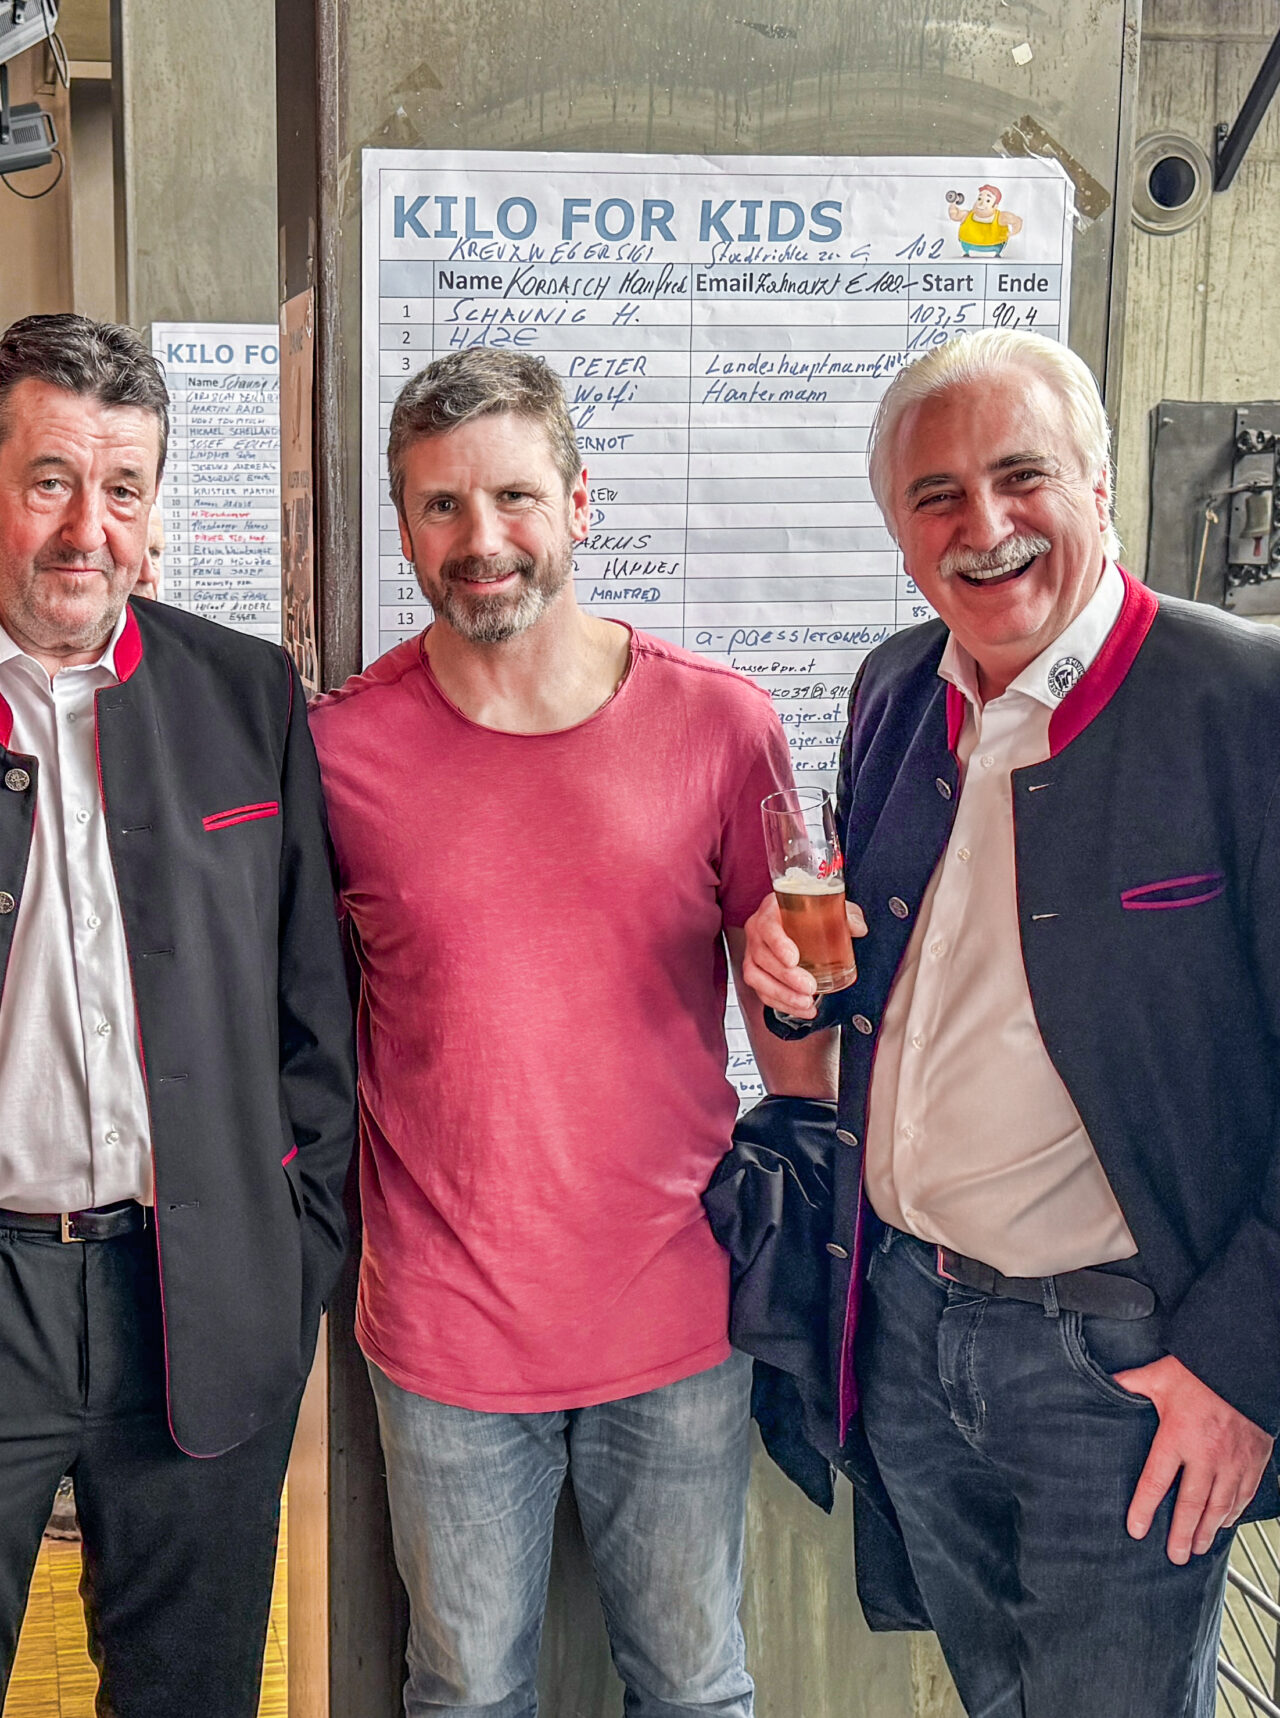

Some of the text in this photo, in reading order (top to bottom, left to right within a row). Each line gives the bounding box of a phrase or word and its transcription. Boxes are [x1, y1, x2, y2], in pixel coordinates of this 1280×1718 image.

[393, 195, 843, 242] KILO FOR KIDS
[438, 270, 503, 290] Name
[696, 272, 754, 292] Email
[922, 273, 974, 293] Start
[997, 273, 1049, 293] Ende
[402, 304, 411, 318] 1
[909, 302, 977, 329] 103,5
[992, 302, 1038, 329] 90,4
[401, 330, 411, 345] 2
[167, 343, 280, 365] KILO FO
[402, 357, 410, 371] 3
[569, 355, 648, 378] PETER
[188, 377, 219, 388] Name
[576, 433, 635, 452] ERNOT
[573, 534, 652, 551] ARKUS
[397, 562, 414, 575] 11
[397, 587, 414, 600] 12
[590, 586, 661, 603] MANFRED
[397, 612, 414, 625] 13
[696, 626, 889, 655] a-paessler@web.d
